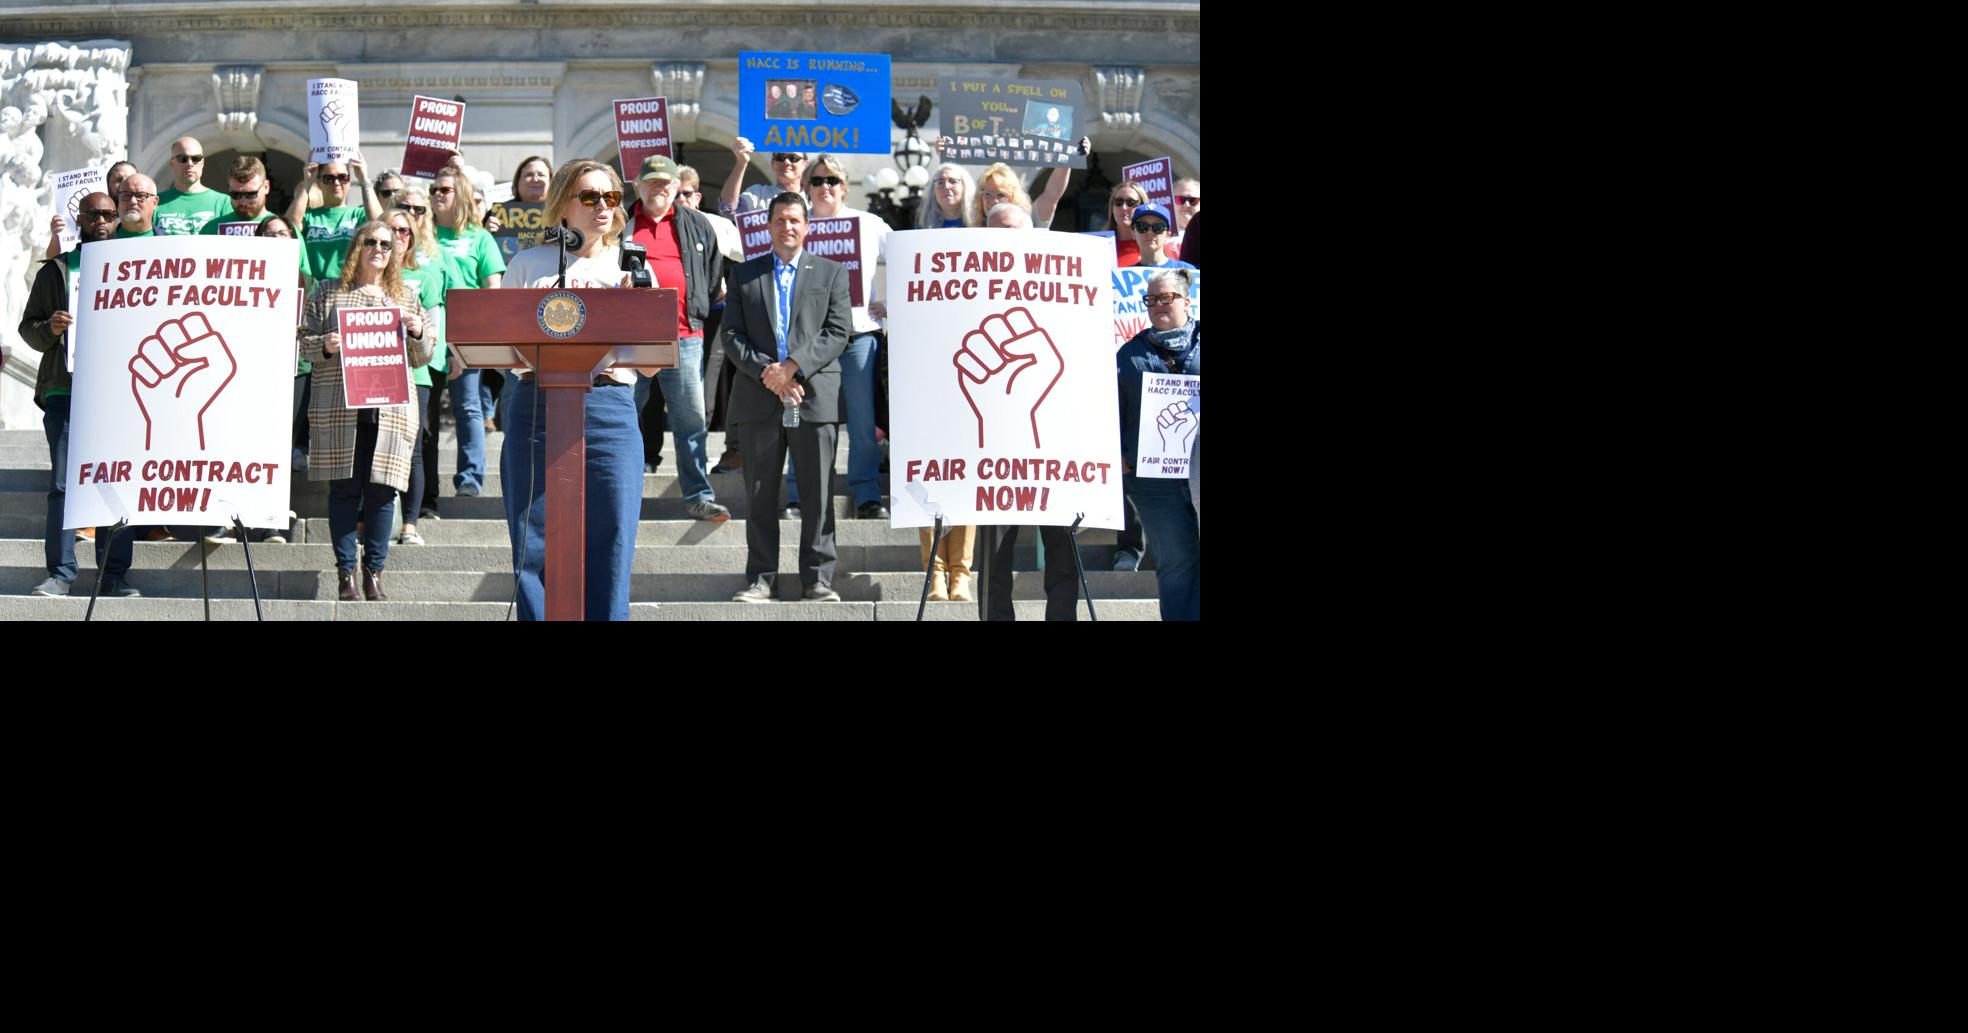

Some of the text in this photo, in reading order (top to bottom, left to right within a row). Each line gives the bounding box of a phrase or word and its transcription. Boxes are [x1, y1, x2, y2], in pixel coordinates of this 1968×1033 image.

[747, 57, 781, 69] HACC
[786, 58, 799, 70] IS
[951, 82, 1067, 98] I PUT A SPELL ON
[419, 100, 458, 117] PROUD
[620, 101, 659, 115] PROUD
[414, 116, 457, 136] UNION
[621, 117, 663, 134] UNION
[954, 115, 970, 135] B
[408, 135, 456, 151] PROFESSOR
[620, 137, 668, 149] PROFESSOR
[764, 125, 860, 149] AMOK!
[1129, 161, 1163, 179] PROUD
[57, 176, 102, 189] HACC FACULTY
[743, 213, 769, 228] PRO
[808, 220, 852, 235] PROUD
[807, 238, 855, 256] UNION
[102, 258, 266, 283] I STAND WITH
[914, 251, 1082, 277] I STAND WITH
[94, 285, 281, 311] HACC FACULTY
[907, 279, 1098, 306] HACC FACULTY
[346, 311, 394, 327] PROUD
[346, 331, 398, 350] UNION
[345, 354, 403, 367] PROFESSOR
[1156, 378, 1181, 386] STAND
[1147, 387, 1200, 397] HACC FACULT
[1141, 456, 1189, 465] FAIR CONTR
[79, 459, 279, 485] FAIR CONTRACT
[906, 457, 1111, 484] FAIR CONTRACT
[1161, 466, 1184, 474] NOW!
[138, 486, 212, 512] NOW!
[975, 486, 1050, 512] NOW!
